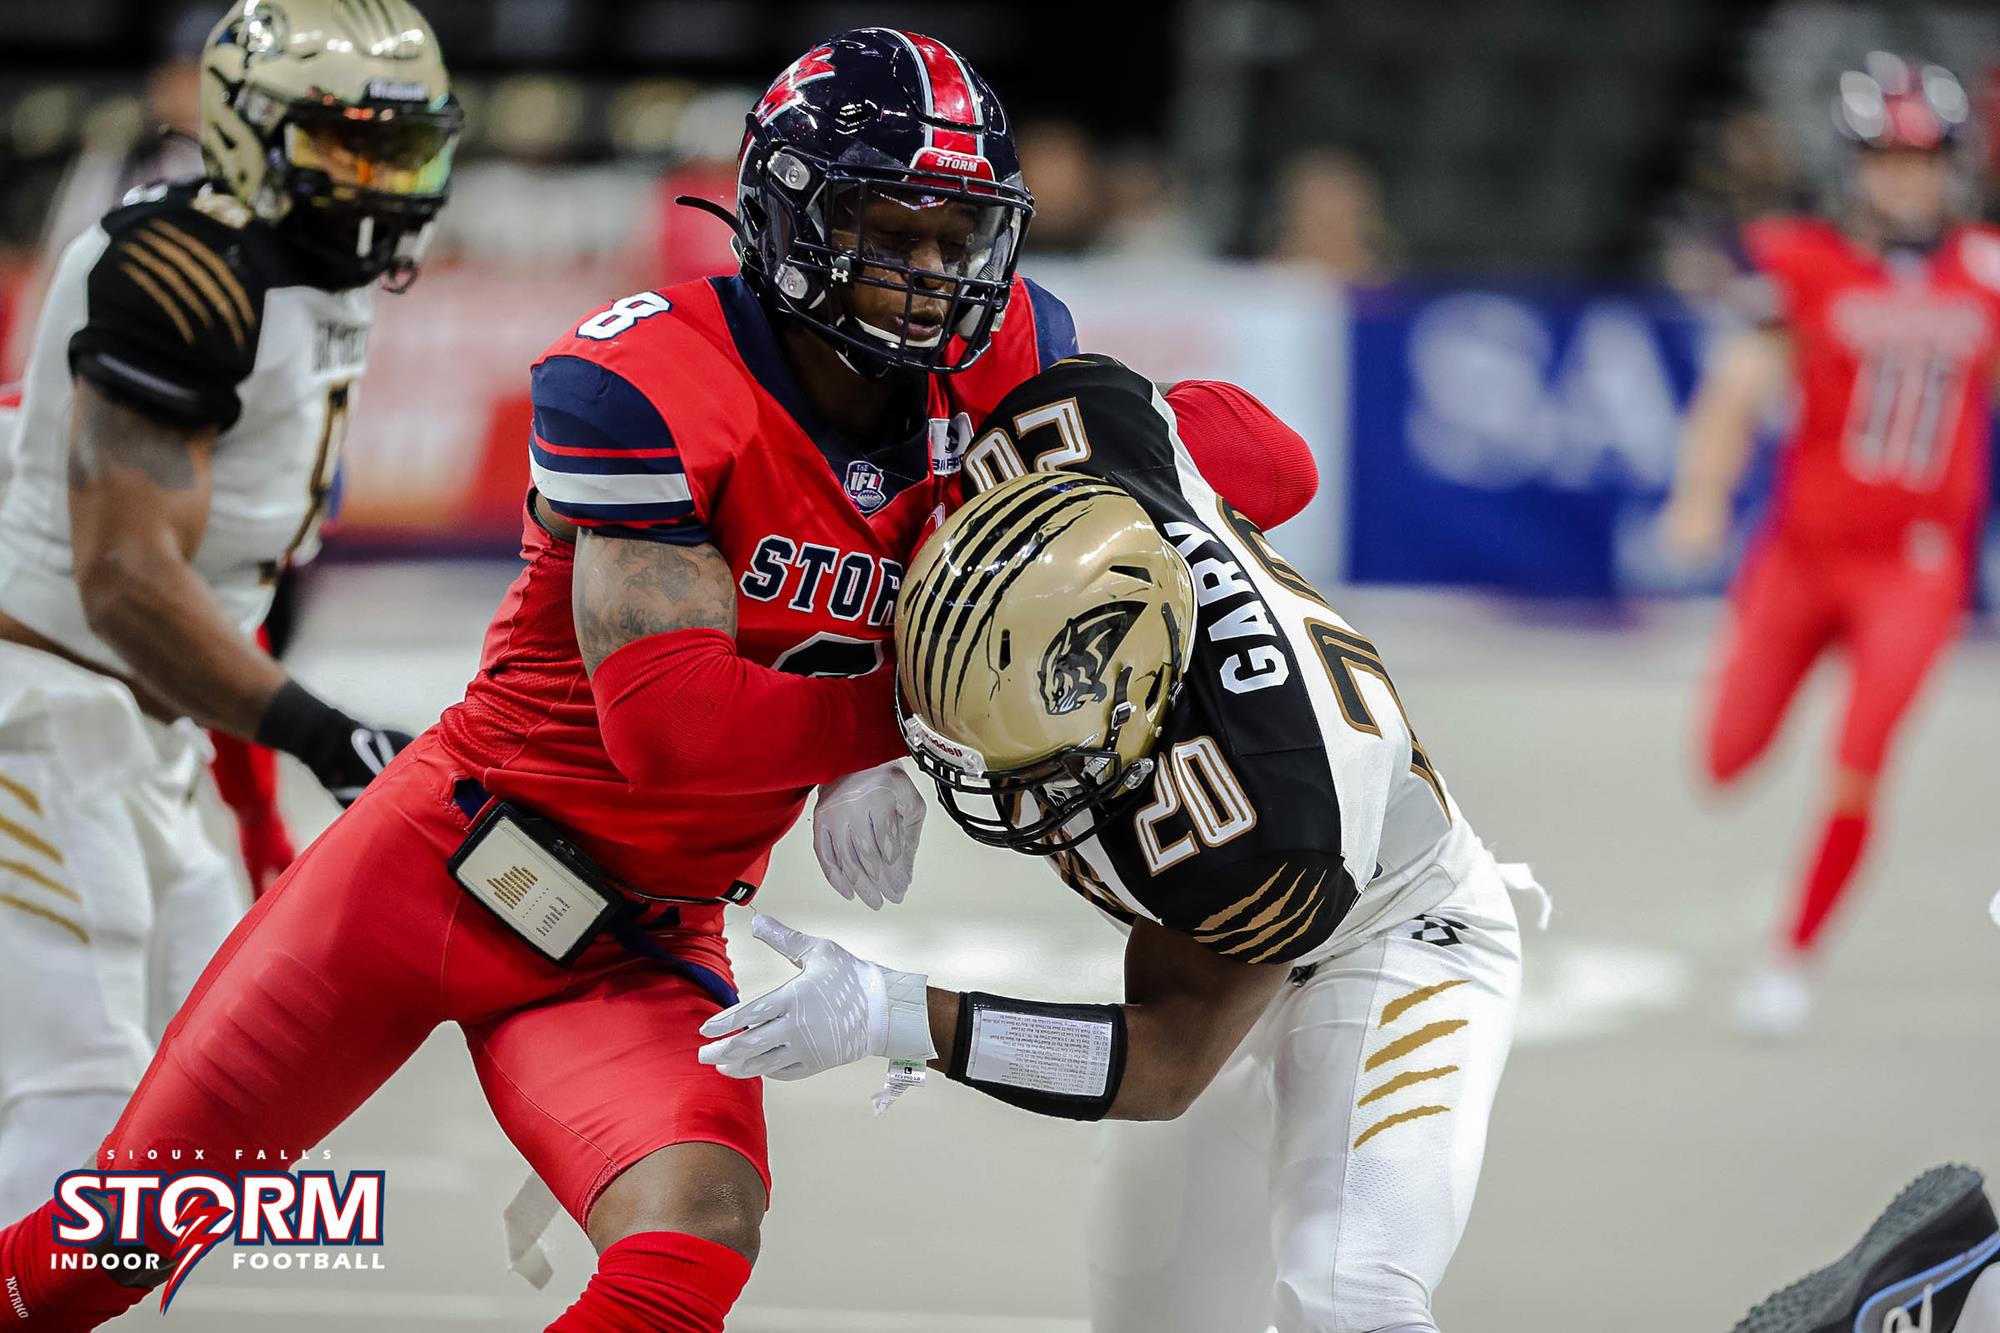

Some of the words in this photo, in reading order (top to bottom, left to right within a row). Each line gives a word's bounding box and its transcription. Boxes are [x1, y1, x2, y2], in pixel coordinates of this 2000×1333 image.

[936, 156, 978, 173] STORM
[576, 290, 673, 341] 8
[850, 471, 880, 492] IFL
[739, 534, 903, 626] STOR
[1163, 521, 1290, 695] GARY
[1133, 735, 1258, 878] 20
